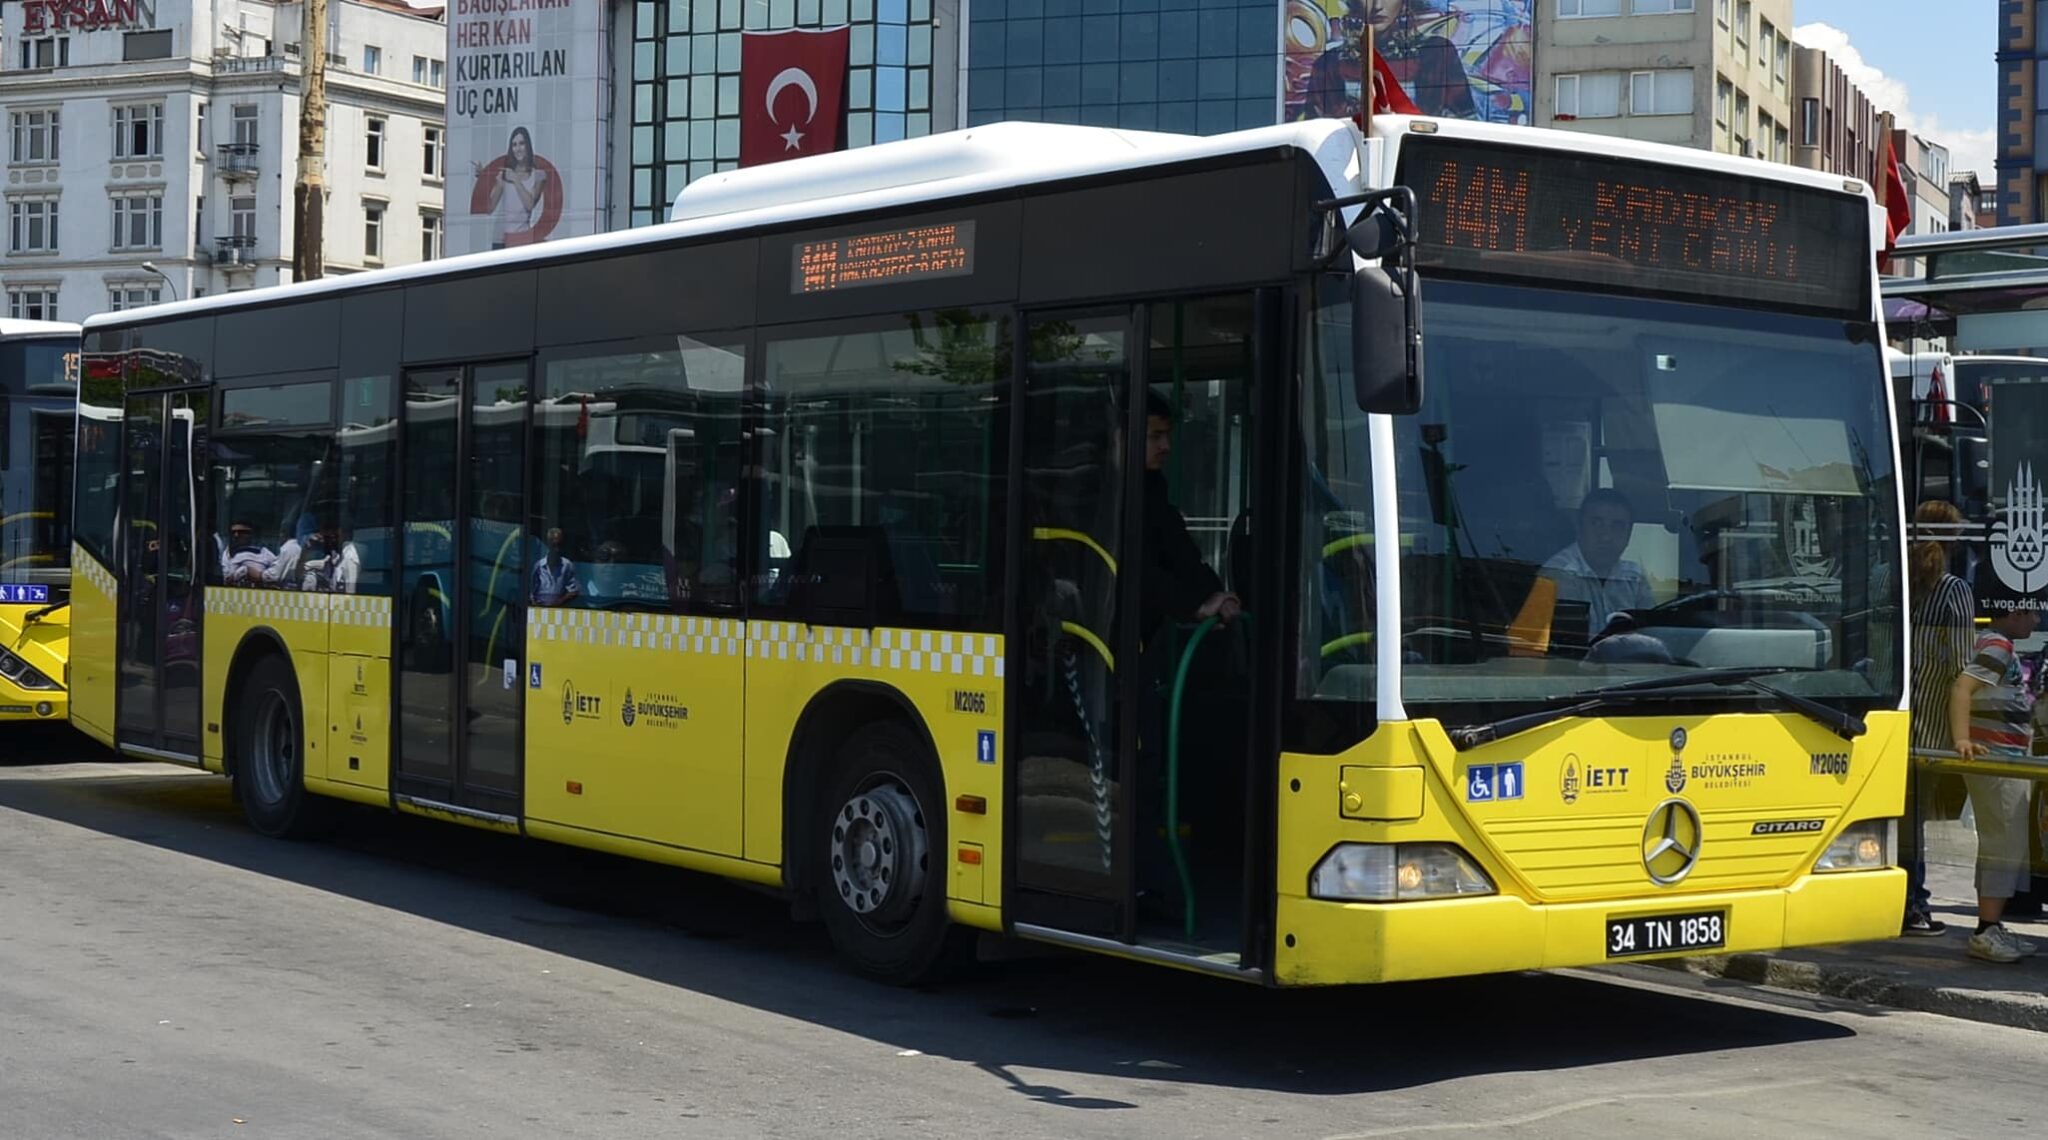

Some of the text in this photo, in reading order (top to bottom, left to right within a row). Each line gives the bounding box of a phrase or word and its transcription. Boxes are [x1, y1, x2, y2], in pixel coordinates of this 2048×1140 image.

[22, 0, 137, 31] EYSAN
[457, 0, 571, 16] BAĞIŞ
[456, 17, 531, 49] HER KAN
[456, 48, 566, 82] KURTARILAN
[456, 85, 519, 119] ÜÇ CAN
[1431, 160, 1529, 253] 14M
[575, 690, 601, 714] İETT
[638, 698, 688, 721] BÜYÜKŞEHİR
[954, 690, 985, 714] M2066
[1705, 752, 1752, 762] İSTANBUL
[1809, 753, 1849, 775] M2066
[1586, 763, 1629, 788] İETT
[1691, 760, 1766, 781] BÜYÜKŞEHİR
[1754, 821, 1822, 834] CITARO
[1611, 915, 1721, 952] 34 TN 1858
